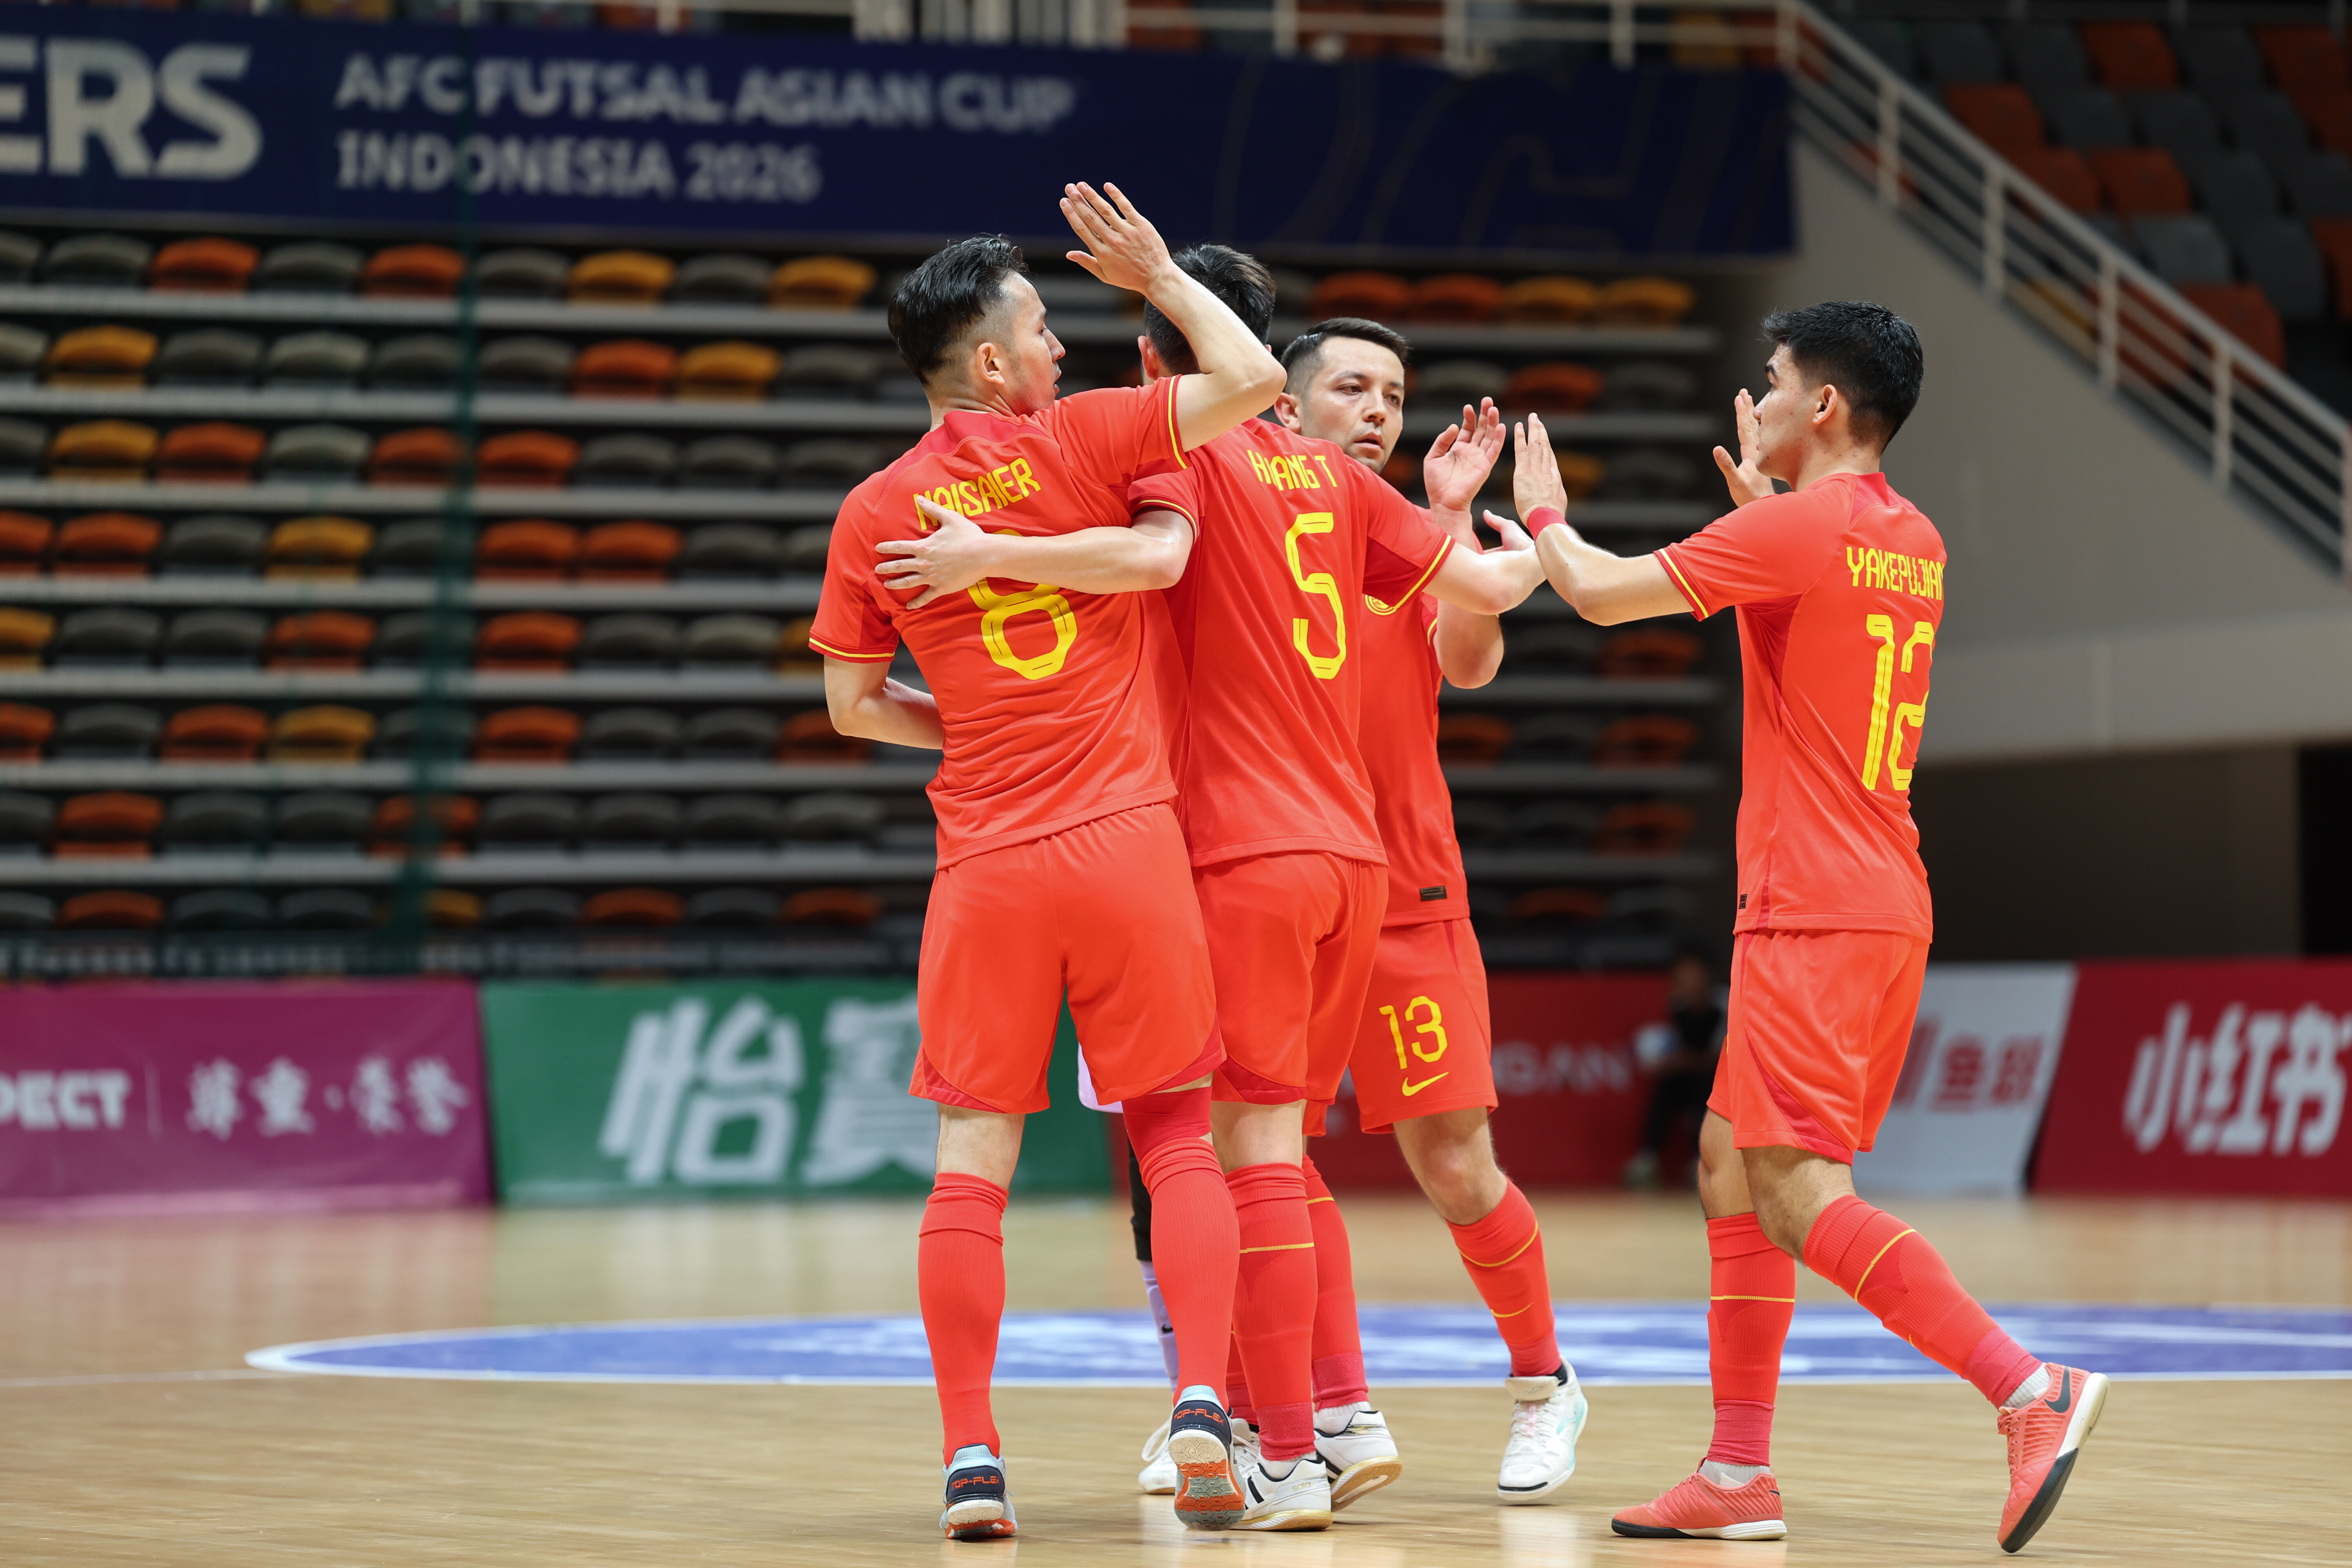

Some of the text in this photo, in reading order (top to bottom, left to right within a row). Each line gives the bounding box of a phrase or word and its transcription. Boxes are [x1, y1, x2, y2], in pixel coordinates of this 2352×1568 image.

[335, 53, 1077, 134] AFC FUTSAL ASIAN CUP
[336, 130, 822, 202] INDONESIA 2026
[1314, 455, 1338, 487] T
[967, 529, 1078, 681] 8
[1285, 512, 1347, 680] 5
[1862, 613, 1935, 791] 12
[1379, 996, 1448, 1069] 13
[2122, 1002, 2352, 1156] 小红书
